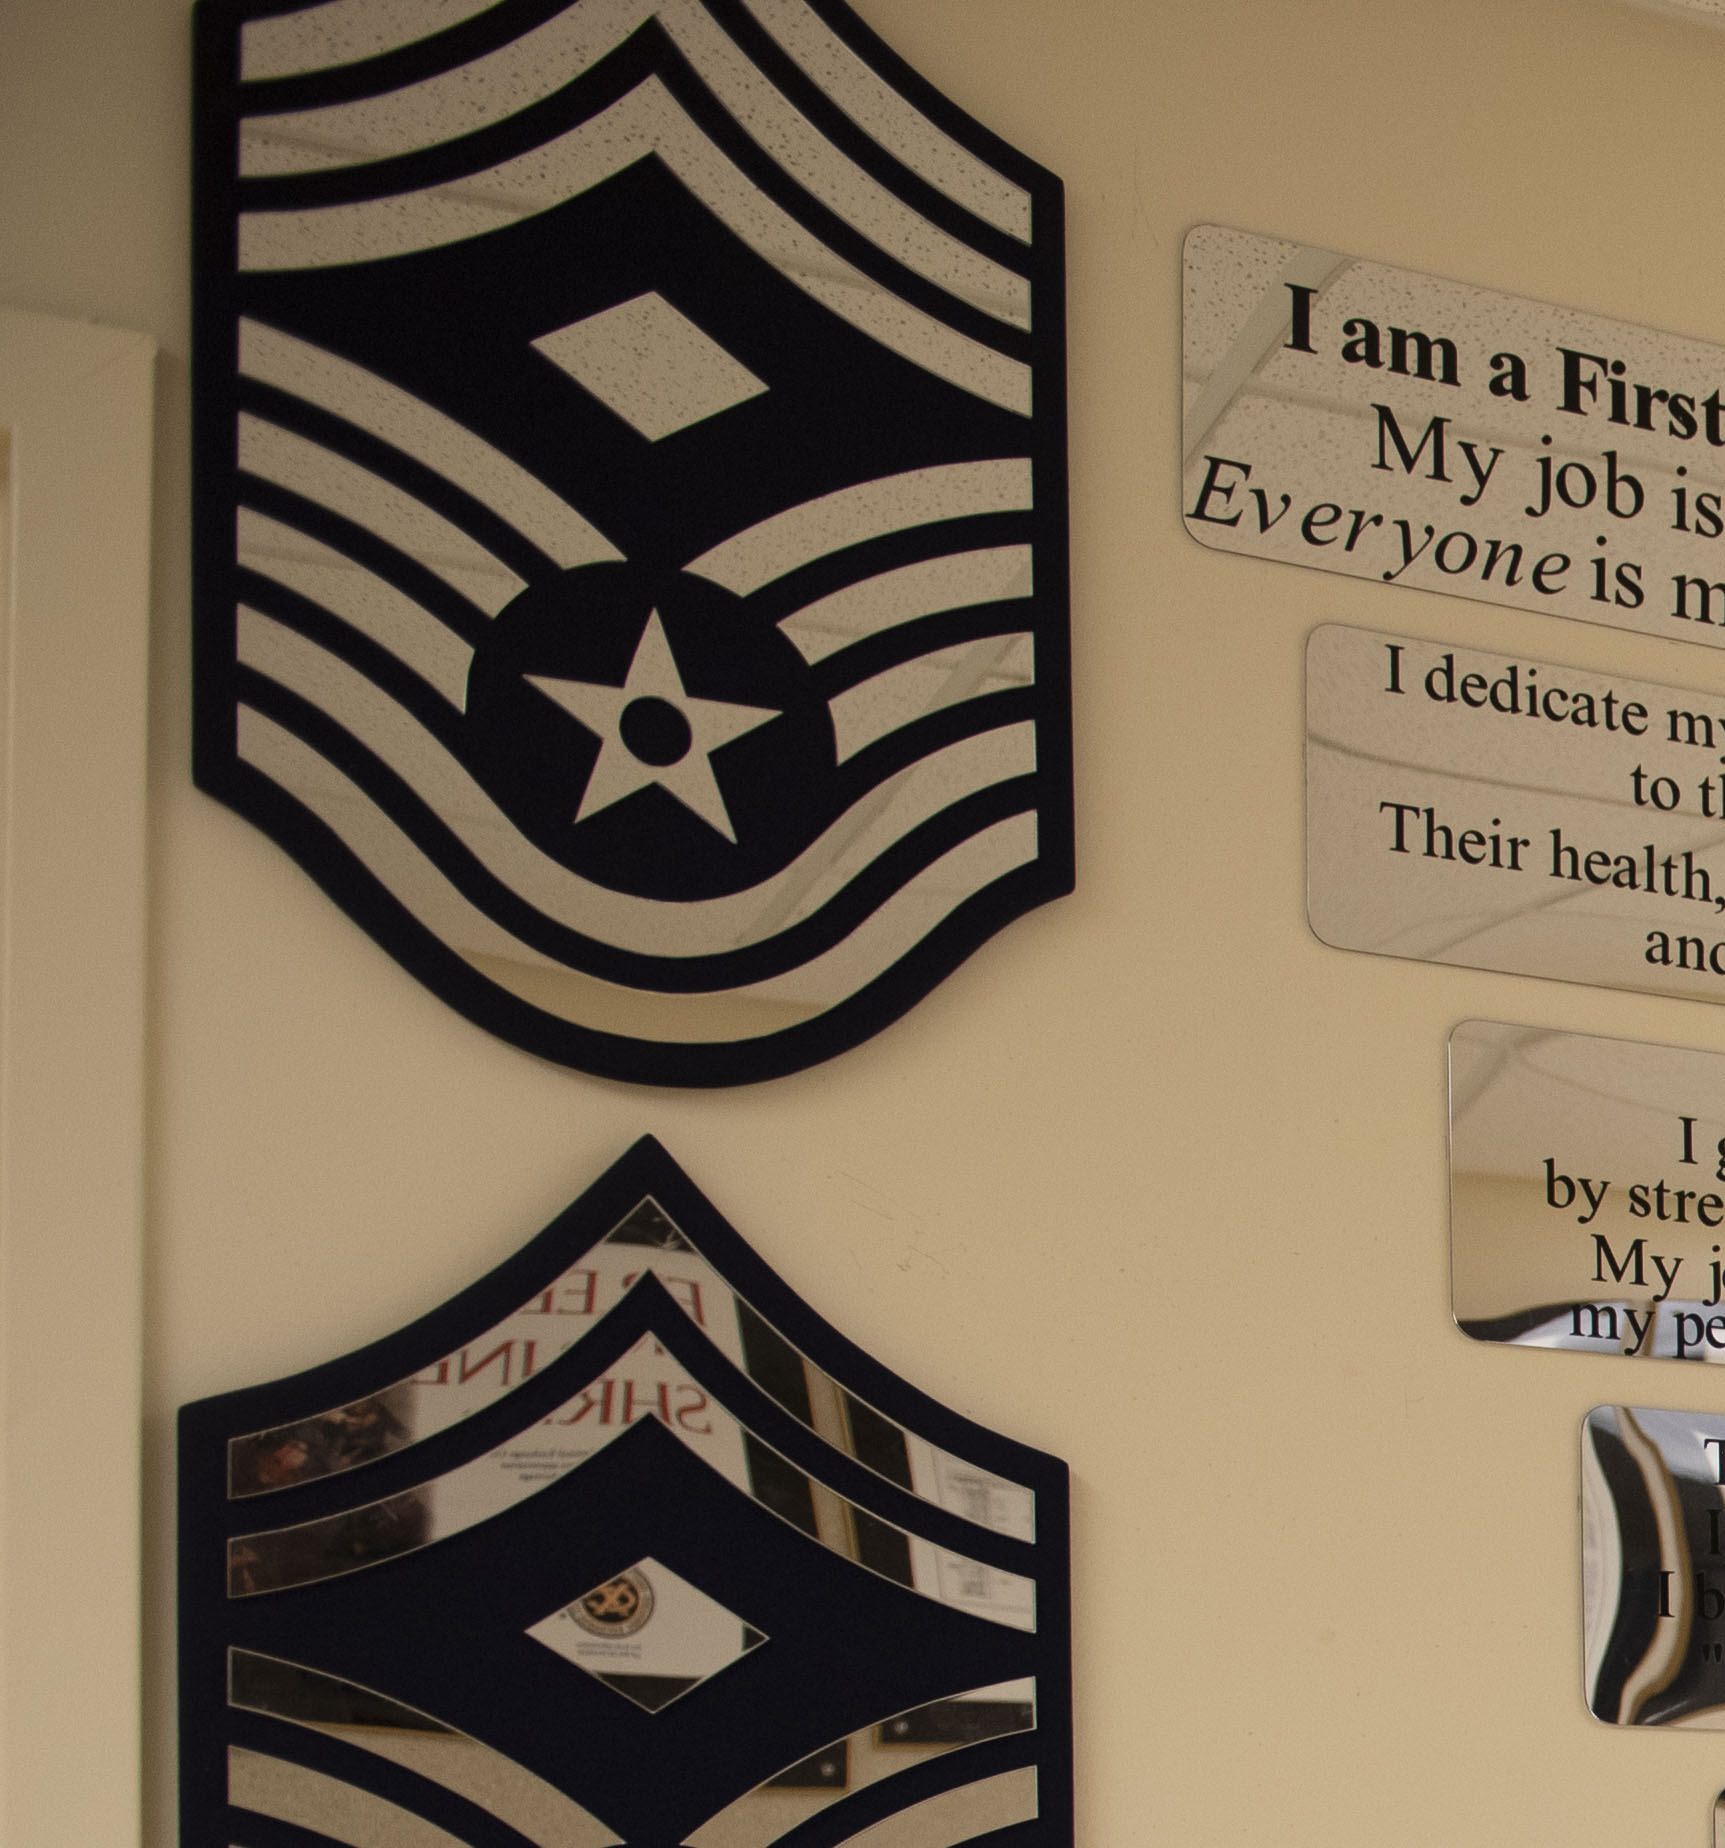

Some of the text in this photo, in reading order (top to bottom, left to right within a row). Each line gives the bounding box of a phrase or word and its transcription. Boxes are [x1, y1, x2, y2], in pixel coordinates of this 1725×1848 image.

[1282, 283, 1318, 355] I
[1341, 314, 1460, 386] am
[1489, 348, 1530, 403] a
[1370, 404, 1504, 507] My
[1526, 435, 1645, 519] job
[1671, 465, 1724, 538] is
[1185, 455, 1572, 597] Everyone
[1590, 533, 1644, 608] is
[1384, 644, 1405, 694] I
[1425, 654, 1649, 737] dedicate
[1630, 762, 1681, 810] to
[1380, 801, 1530, 872] Their
[1678, 1116, 1698, 1165] I
[1544, 1158, 1611, 1218] by
[1590, 1234, 1683, 1302] My
[1570, 1303, 1655, 1355] my
[1706, 1509, 1725, 1557] I
[1657, 1570, 1676, 1619] I
